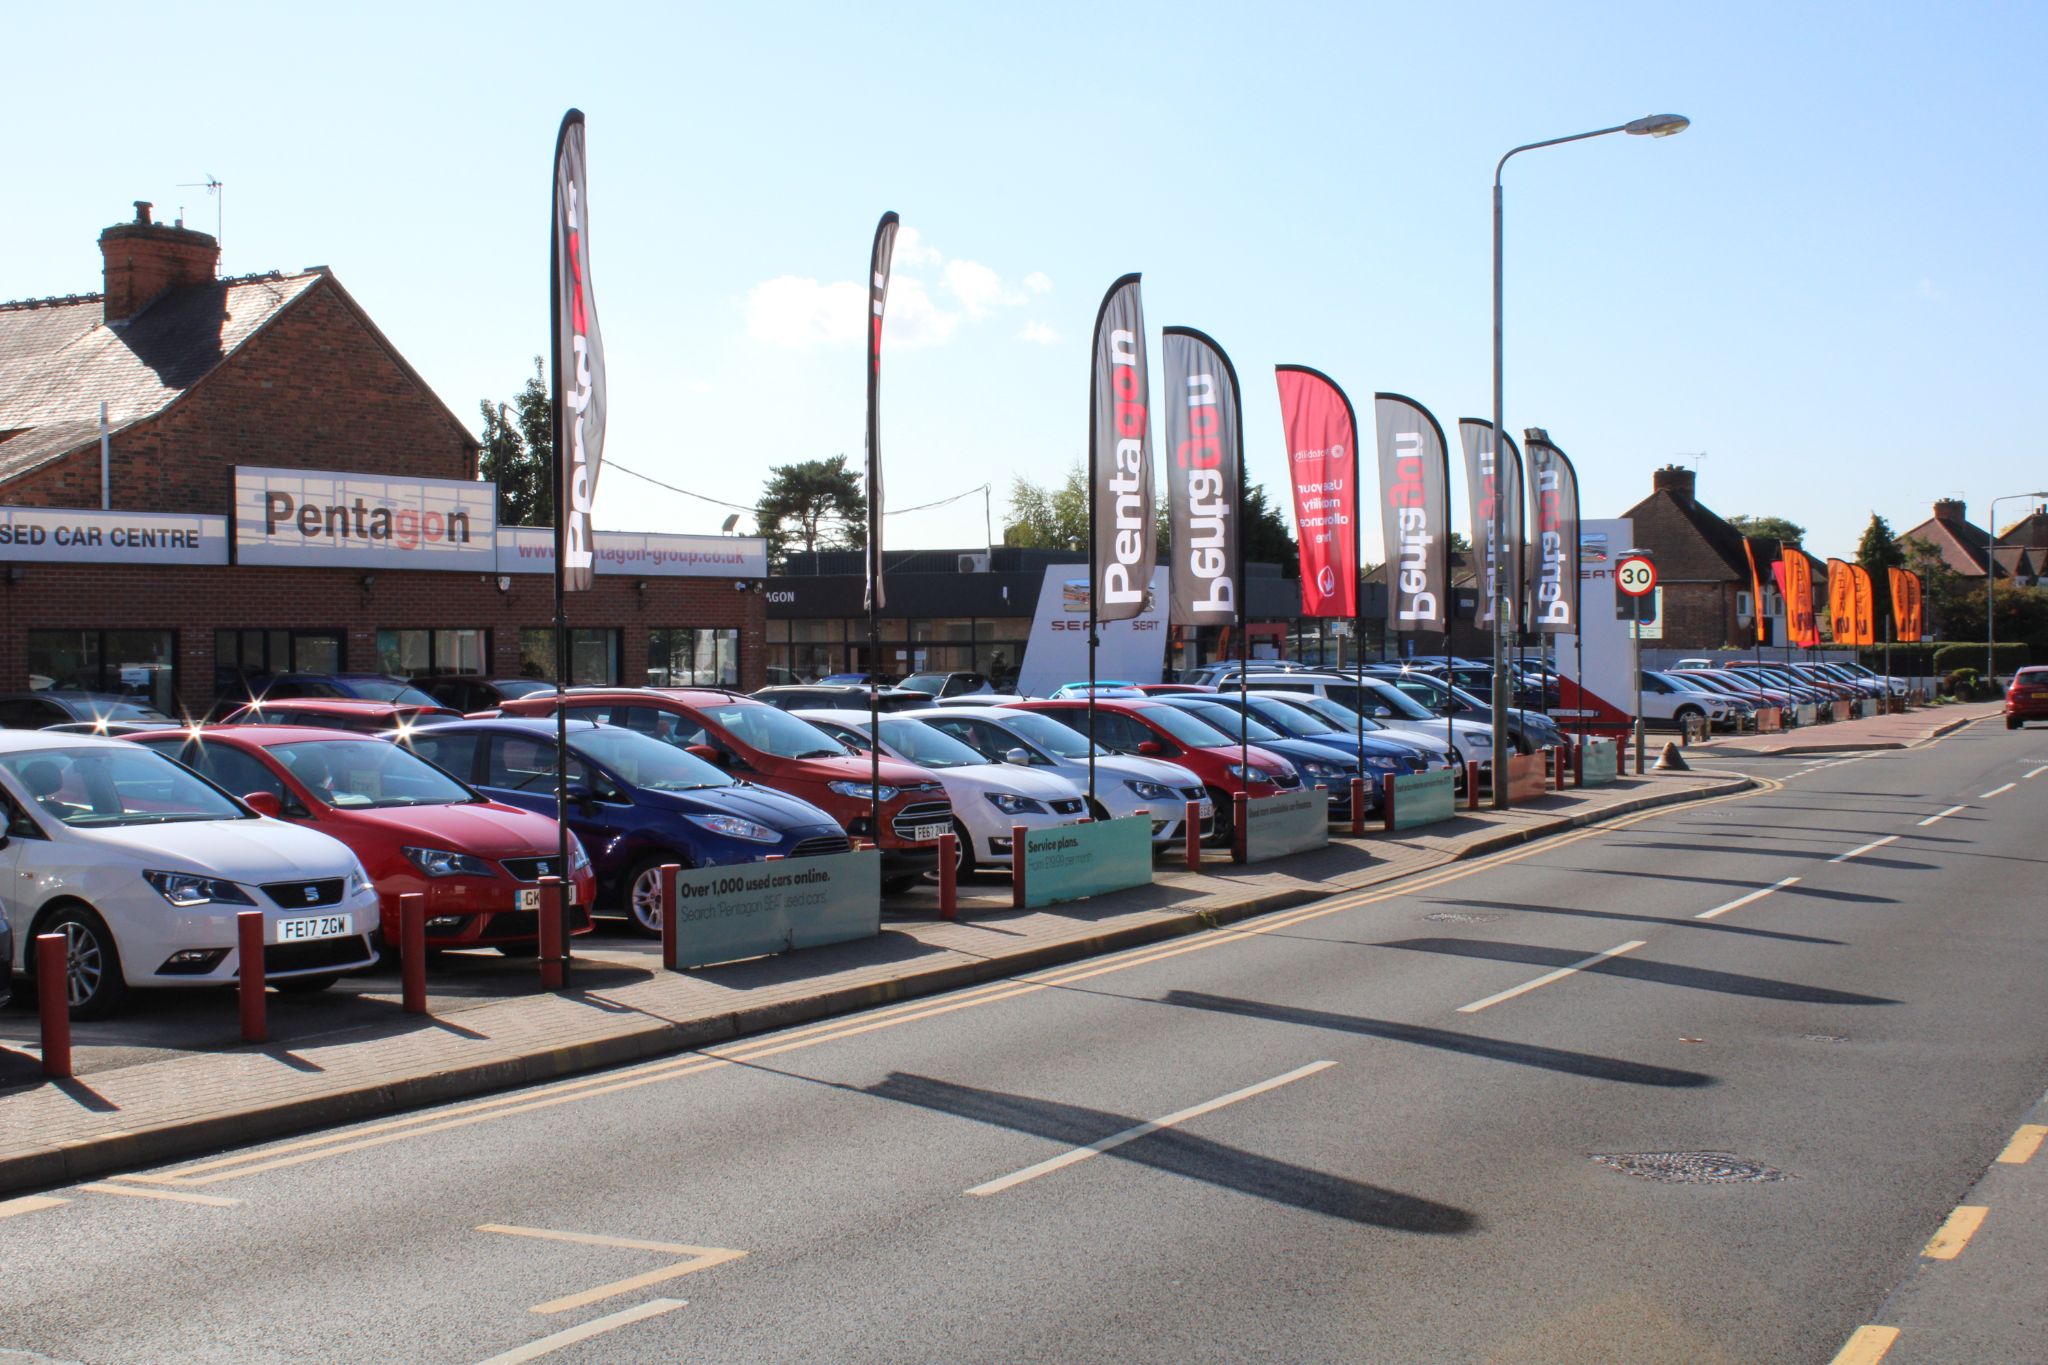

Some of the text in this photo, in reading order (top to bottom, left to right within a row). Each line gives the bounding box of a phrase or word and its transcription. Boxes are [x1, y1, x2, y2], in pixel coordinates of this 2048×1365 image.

[1104, 328, 1147, 604] Pentagon
[266, 490, 471, 551] Pentagon
[0, 524, 199, 549] SED CAR CENTRE
[1580, 569, 1616, 580] EAT
[1621, 568, 1650, 584] 30
[765, 591, 795, 603] AGON
[1132, 620, 1160, 631] SEAT
[1028, 838, 1057, 853] Service
[681, 868, 831, 898] Over 1,000 used cars online.
[681, 903, 716, 922] Search
[285, 919, 318, 939] FE17
